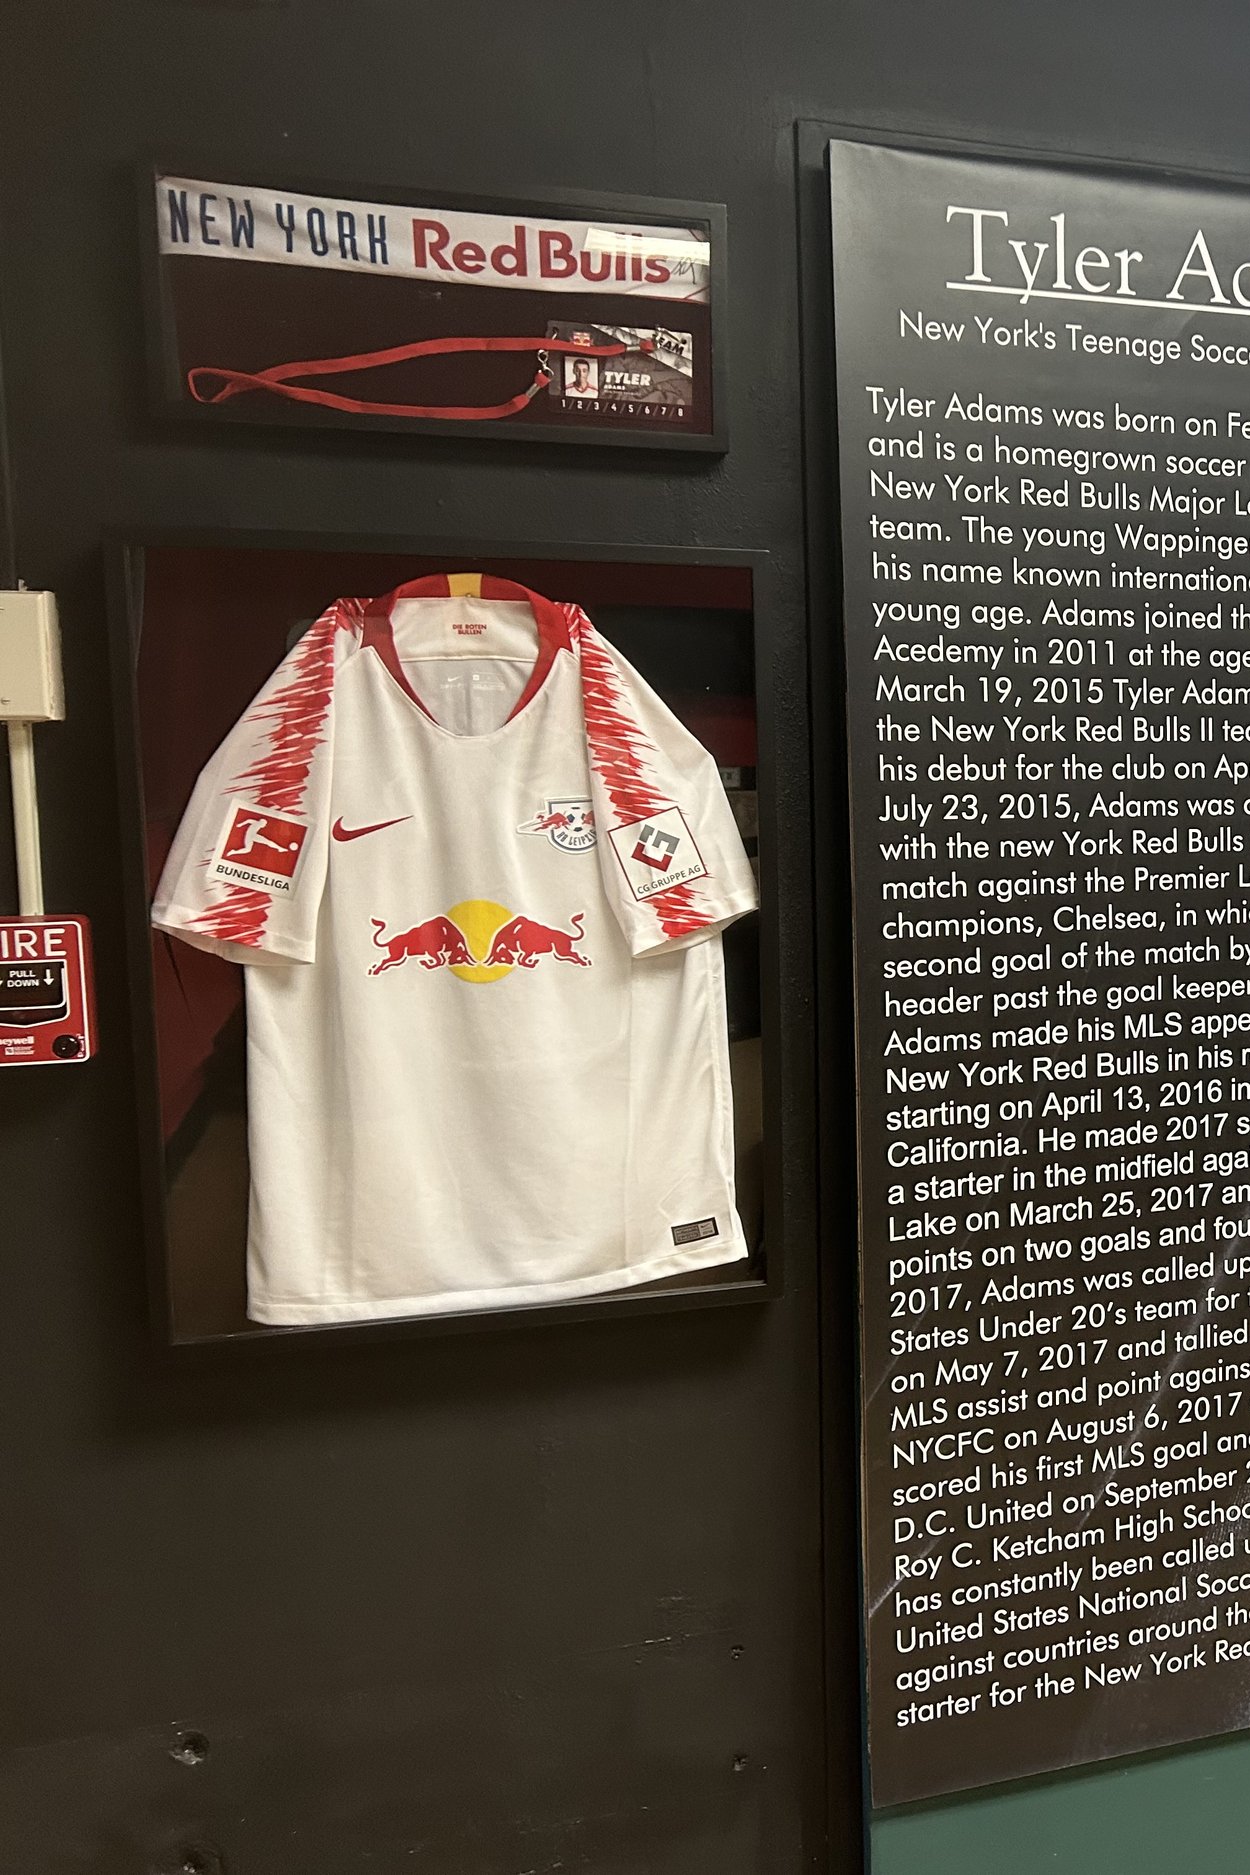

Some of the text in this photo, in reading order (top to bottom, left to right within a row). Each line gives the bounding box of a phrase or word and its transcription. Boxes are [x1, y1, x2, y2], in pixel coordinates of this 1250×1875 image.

[168, 189, 254, 248] NEW
[276, 202, 389, 264] YORK
[946, 204, 1143, 304] Tyler
[900, 312, 964, 343] New
[973, 317, 1057, 349] York's
[1066, 325, 1182, 365] Teenage
[604, 371, 651, 386] TYLER
[865, 386, 936, 423] Tyler
[944, 391, 1043, 426] Adams
[1051, 408, 1105, 430] was
[1115, 402, 1175, 434] born
[1185, 417, 1217, 437] on
[868, 430, 924, 459] and
[935, 432, 956, 461] is
[966, 443, 983, 463] a
[995, 434, 1156, 475] homegrown
[1165, 455, 1247, 477] soccer
[870, 469, 936, 501] New
[943, 474, 1011, 504] York
[1020, 478, 1069, 508] Red
[1080, 481, 1141, 511] Bulls
[1149, 485, 1226, 521] Major
[869, 514, 951, 542] team.
[961, 515, 1014, 545] The
[1021, 527, 1106, 555] young
[875, 713, 921, 742] the
[931, 715, 995, 743] New
[1002, 715, 1067, 743] York
[1075, 715, 1123, 743] Red
[1133, 715, 1191, 743] Bulls
[1200, 716, 1213, 742] II
[556, 831, 568, 842] RB
[216, 864, 290, 891] BUNDESLIGA
[637, 864, 701, 894] CG GRUPPE AG
[0, 928, 66, 958] IRE
[882, 909, 1043, 943] champions,
[1053, 903, 1166, 932] Chelsea,
[1175, 902, 1197, 927] in
[7, 979, 40, 988] DOWN
[9, 970, 36, 978] PULL
[886, 1067, 951, 1094] New
[957, 1059, 1024, 1088] York
[1032, 1053, 1087, 1082] Red
[1096, 1049, 1160, 1078] Bulls
[1167, 1047, 1189, 1072] in
[1198, 1044, 1234, 1070] his
[891, 1397, 949, 1432] MLS
[957, 1388, 1029, 1420] assist
[1037, 1376, 1087, 1409] and
[1097, 1370, 1162, 1407] point
[896, 1693, 982, 1727] starter
[988, 1681, 1028, 1708] for
[1034, 1672, 1076, 1699] the
[1084, 1662, 1143, 1690] New
[1149, 1643, 1207, 1676] York
